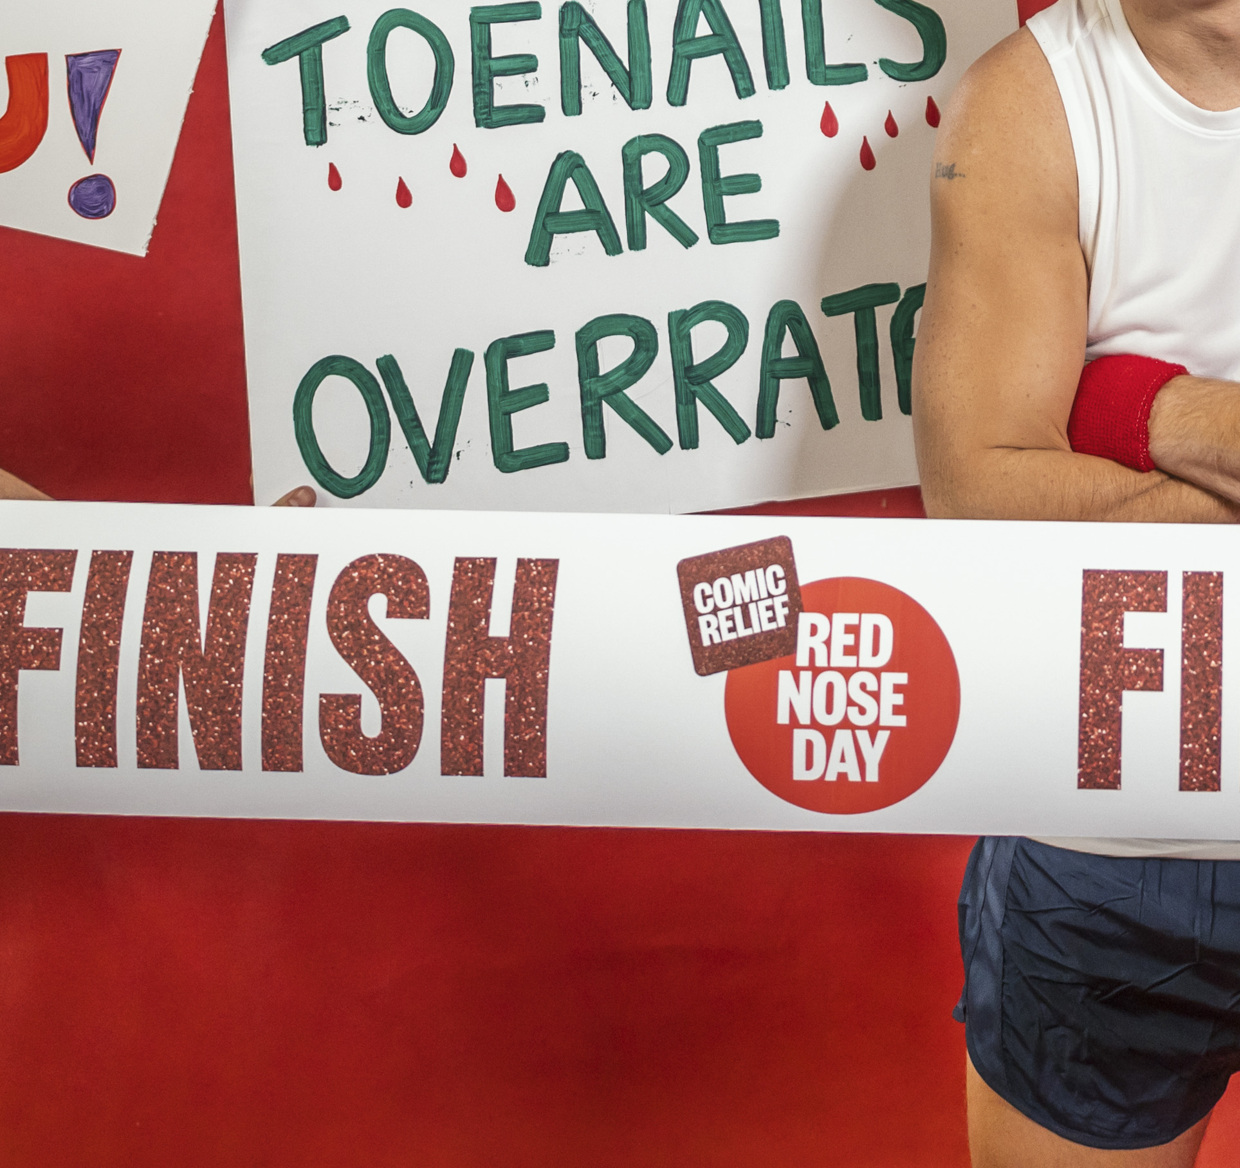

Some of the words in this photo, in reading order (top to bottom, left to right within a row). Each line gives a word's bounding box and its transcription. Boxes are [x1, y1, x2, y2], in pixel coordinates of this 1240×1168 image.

[524, 119, 781, 268] ARE
[693, 564, 787, 614] COMIC
[698, 594, 790, 647] RELIEF
[796, 612, 894, 668] RED
[0, 548, 560, 778] FINISH
[777, 670, 909, 727] NOSE
[792, 728, 891, 782] DAY
